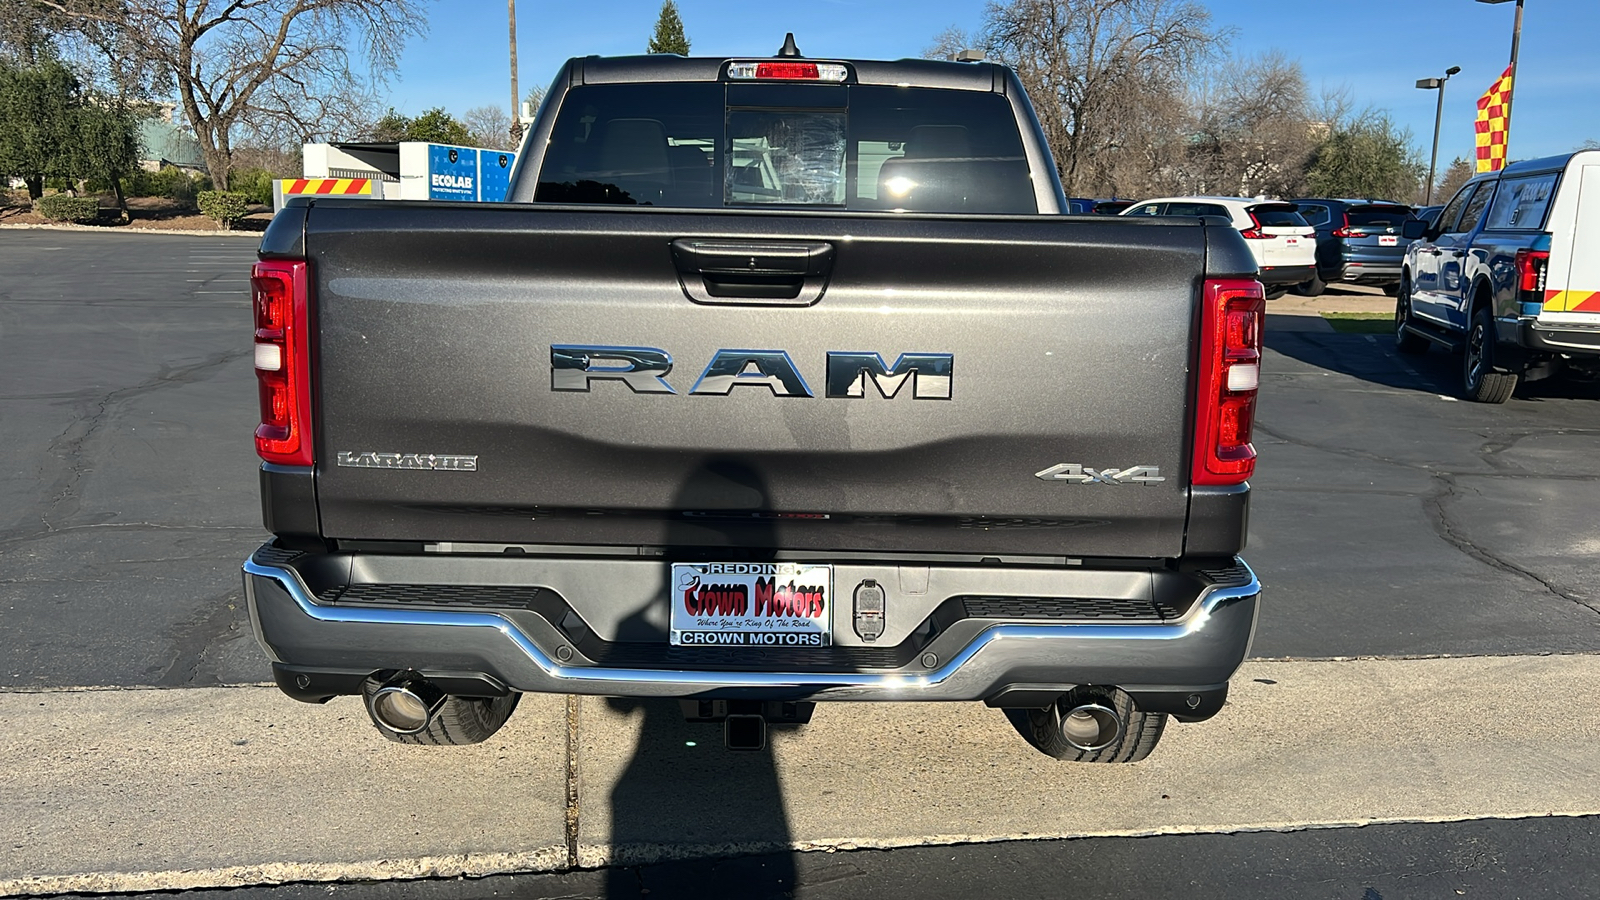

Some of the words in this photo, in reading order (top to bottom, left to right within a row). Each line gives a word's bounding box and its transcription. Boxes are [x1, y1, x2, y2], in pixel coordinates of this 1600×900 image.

[432, 174, 473, 189] ECOLAB
[550, 344, 954, 400] RAM
[337, 452, 479, 472] LARAMIE
[711, 564, 795, 574] REDDING
[684, 576, 749, 617] Crown
[754, 575, 825, 618] Motors
[697, 618, 718, 627] Where
[744, 619, 762, 629] King
[764, 619, 775, 629] Of
[776, 619, 789, 628] The
[791, 619, 811, 628] Road
[681, 633, 745, 645] CROWN
[751, 633, 821, 645] MOTORS
